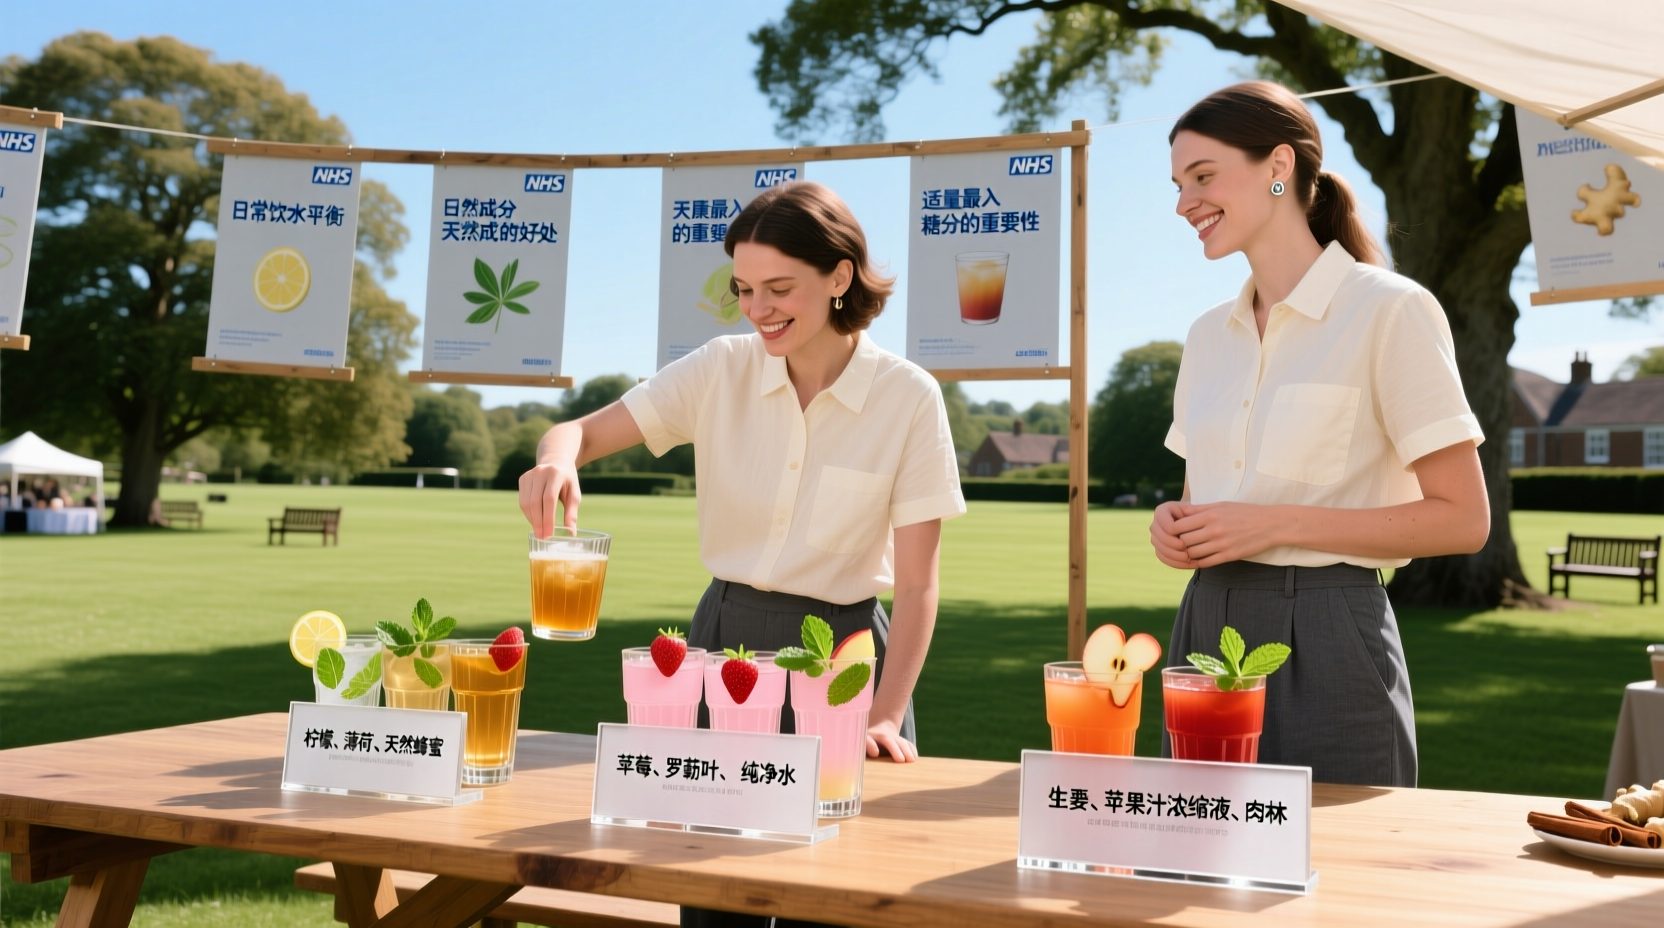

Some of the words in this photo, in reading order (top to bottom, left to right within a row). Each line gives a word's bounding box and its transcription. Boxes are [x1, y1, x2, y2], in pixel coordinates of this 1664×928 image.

[0, 131, 35, 152] NHS
[1010, 156, 1052, 174] NHS
[313, 167, 352, 185] NHS
[525, 175, 565, 192] NHS
[756, 170, 796, 187] NHS
[232, 199, 345, 227] 日常饮水平衡
[921, 210, 1040, 236] 糖分的重要性
